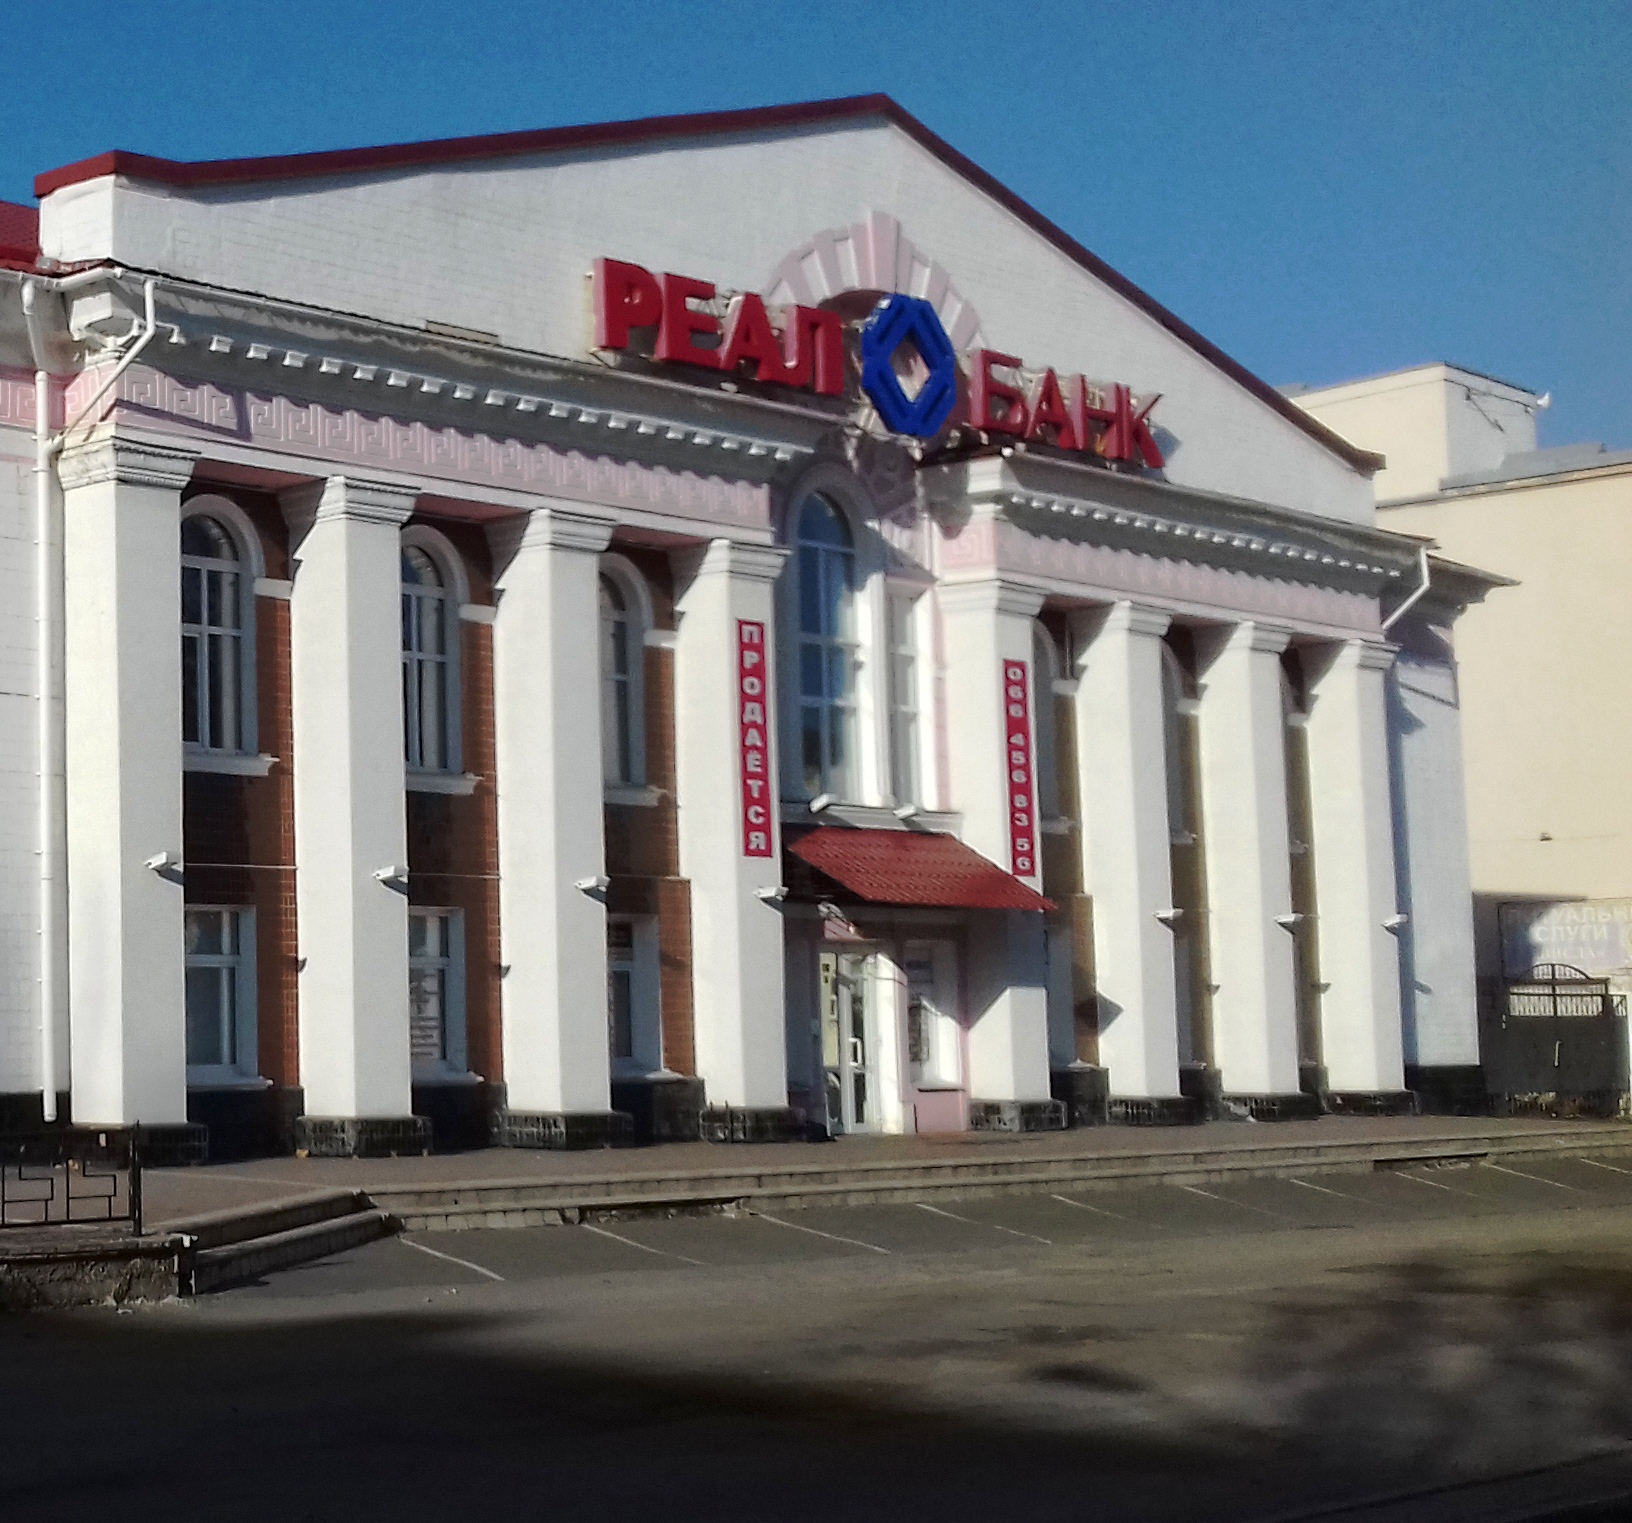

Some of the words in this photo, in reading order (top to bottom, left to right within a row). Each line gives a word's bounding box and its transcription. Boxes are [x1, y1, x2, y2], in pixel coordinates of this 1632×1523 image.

[593, 256, 844, 395] РЕАЛ
[969, 349, 1165, 468] БАНК
[741, 624, 767, 851] ПРОДАЁТСЯ
[1015, 837, 1032, 871] 56
